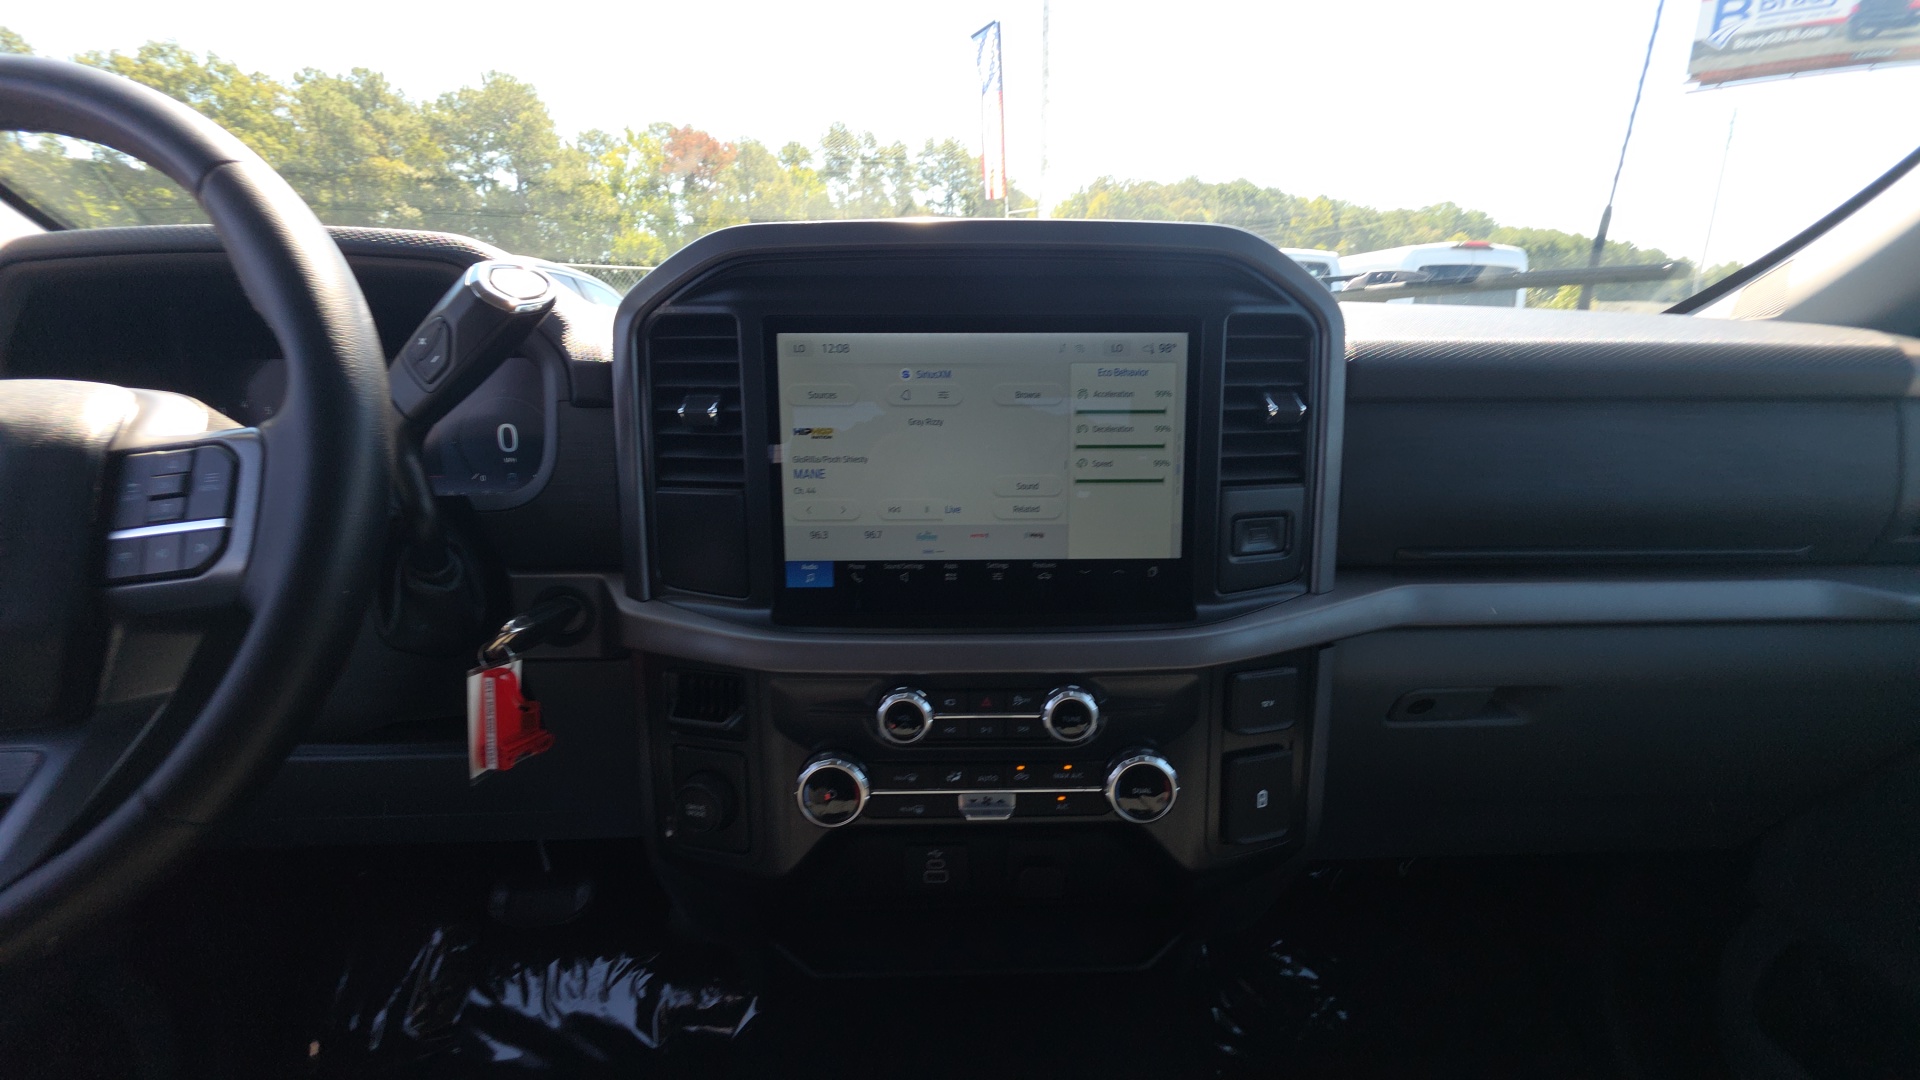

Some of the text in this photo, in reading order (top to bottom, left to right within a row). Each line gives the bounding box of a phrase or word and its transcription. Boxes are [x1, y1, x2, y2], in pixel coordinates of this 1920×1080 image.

[793, 343, 807, 354] LO
[1110, 343, 1123, 353] LO
[916, 369, 952, 379] SiriusXM
[1097, 368, 1150, 378] Eco Behavior
[807, 390, 838, 400] Sources
[1014, 390, 1042, 399] Browse
[1092, 389, 1173, 399] Acceleration 99%
[1092, 424, 1172, 433] Deceleration 99%
[496, 423, 519, 453] 0
[1091, 458, 1171, 469] Speed 99%
[793, 468, 826, 479] MANE
[1016, 482, 1040, 491] Sound
[944, 504, 962, 514] Live
[1012, 504, 1041, 513] Related
